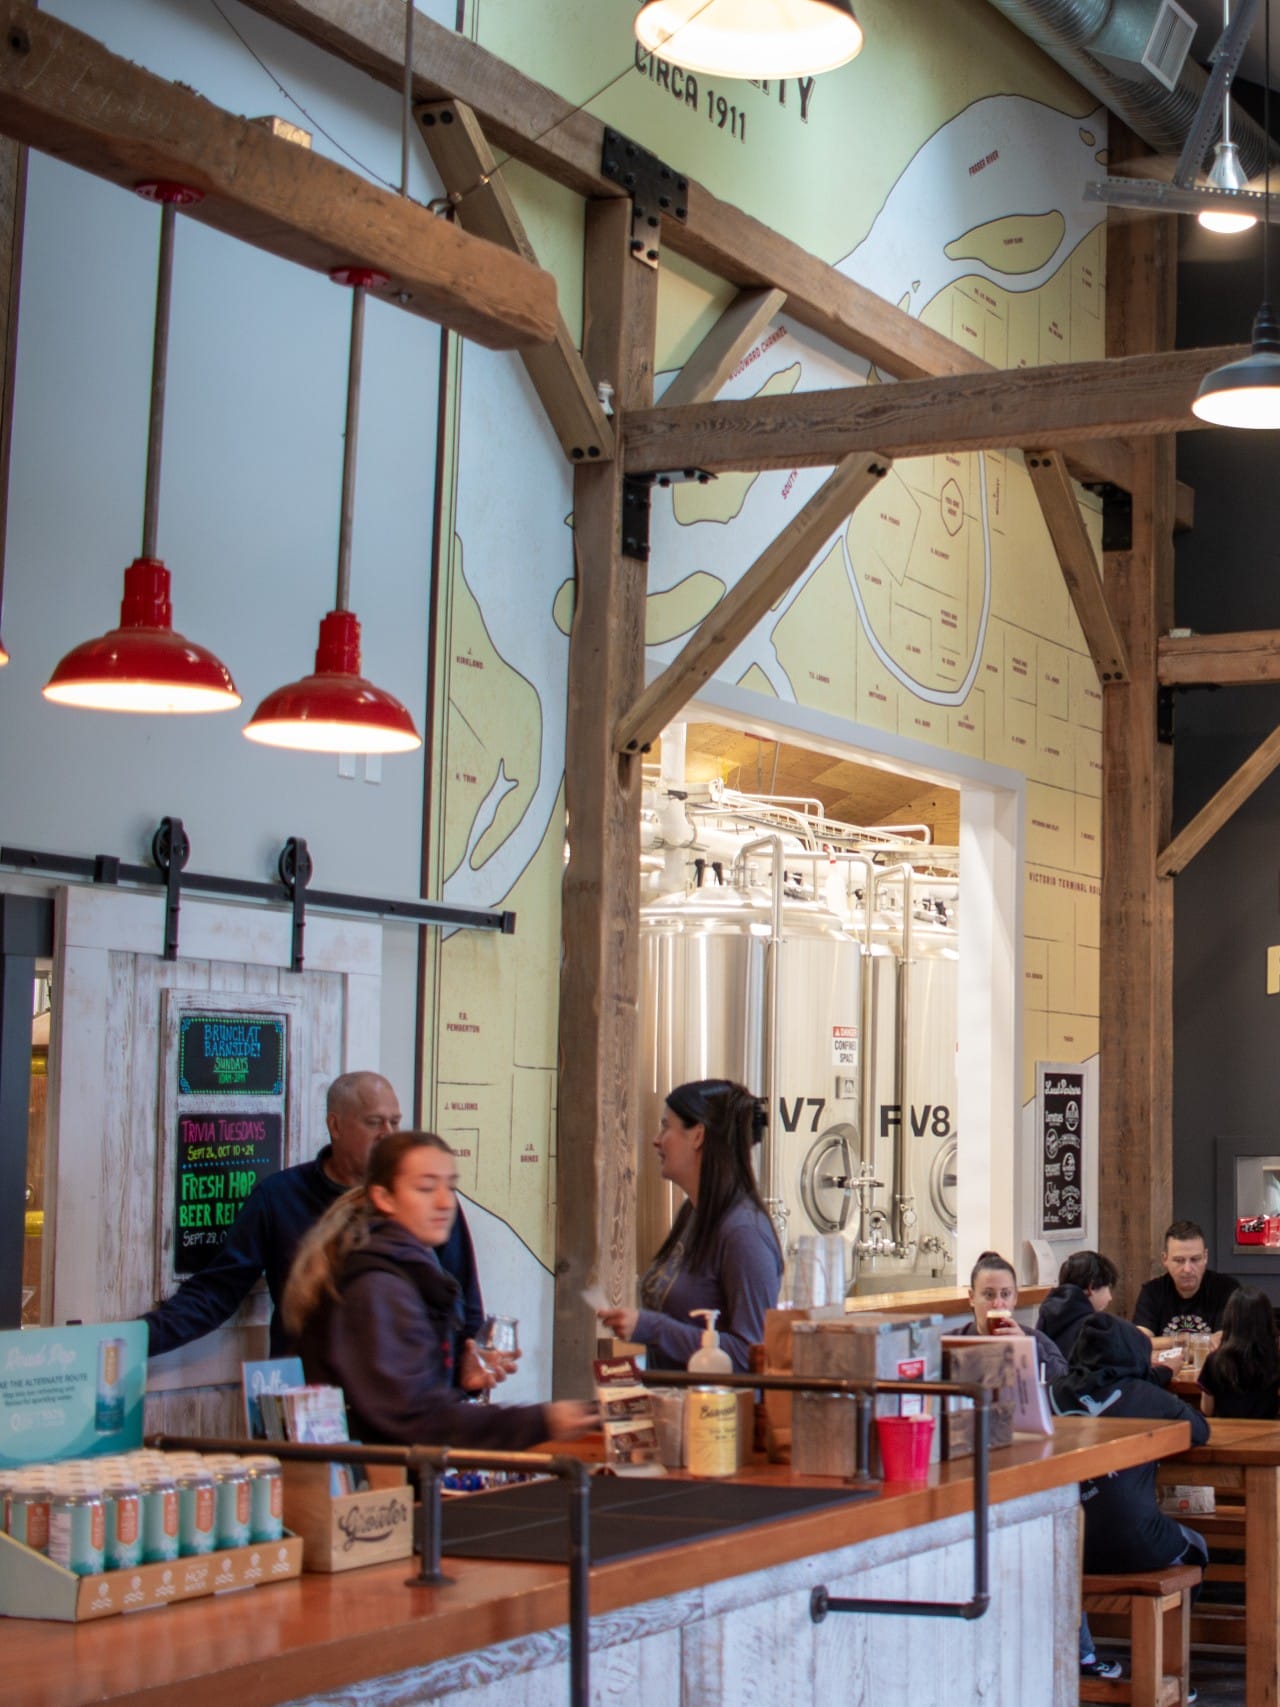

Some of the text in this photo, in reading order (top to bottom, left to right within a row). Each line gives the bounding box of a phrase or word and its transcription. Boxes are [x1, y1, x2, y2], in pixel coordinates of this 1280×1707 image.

[634, 39, 698, 112] CIRCA
[707, 90, 746, 144] 1911
[204, 1024, 262, 1042] BRUNCH AT
[204, 1041, 261, 1057] BARNSIDE!
[214, 1057, 249, 1070] SUNDAYS
[181, 1119, 266, 1143] TRIVIA TUESDAYS
[182, 1170, 257, 1201] FRESH HOP
[179, 1203, 212, 1228] BEER
